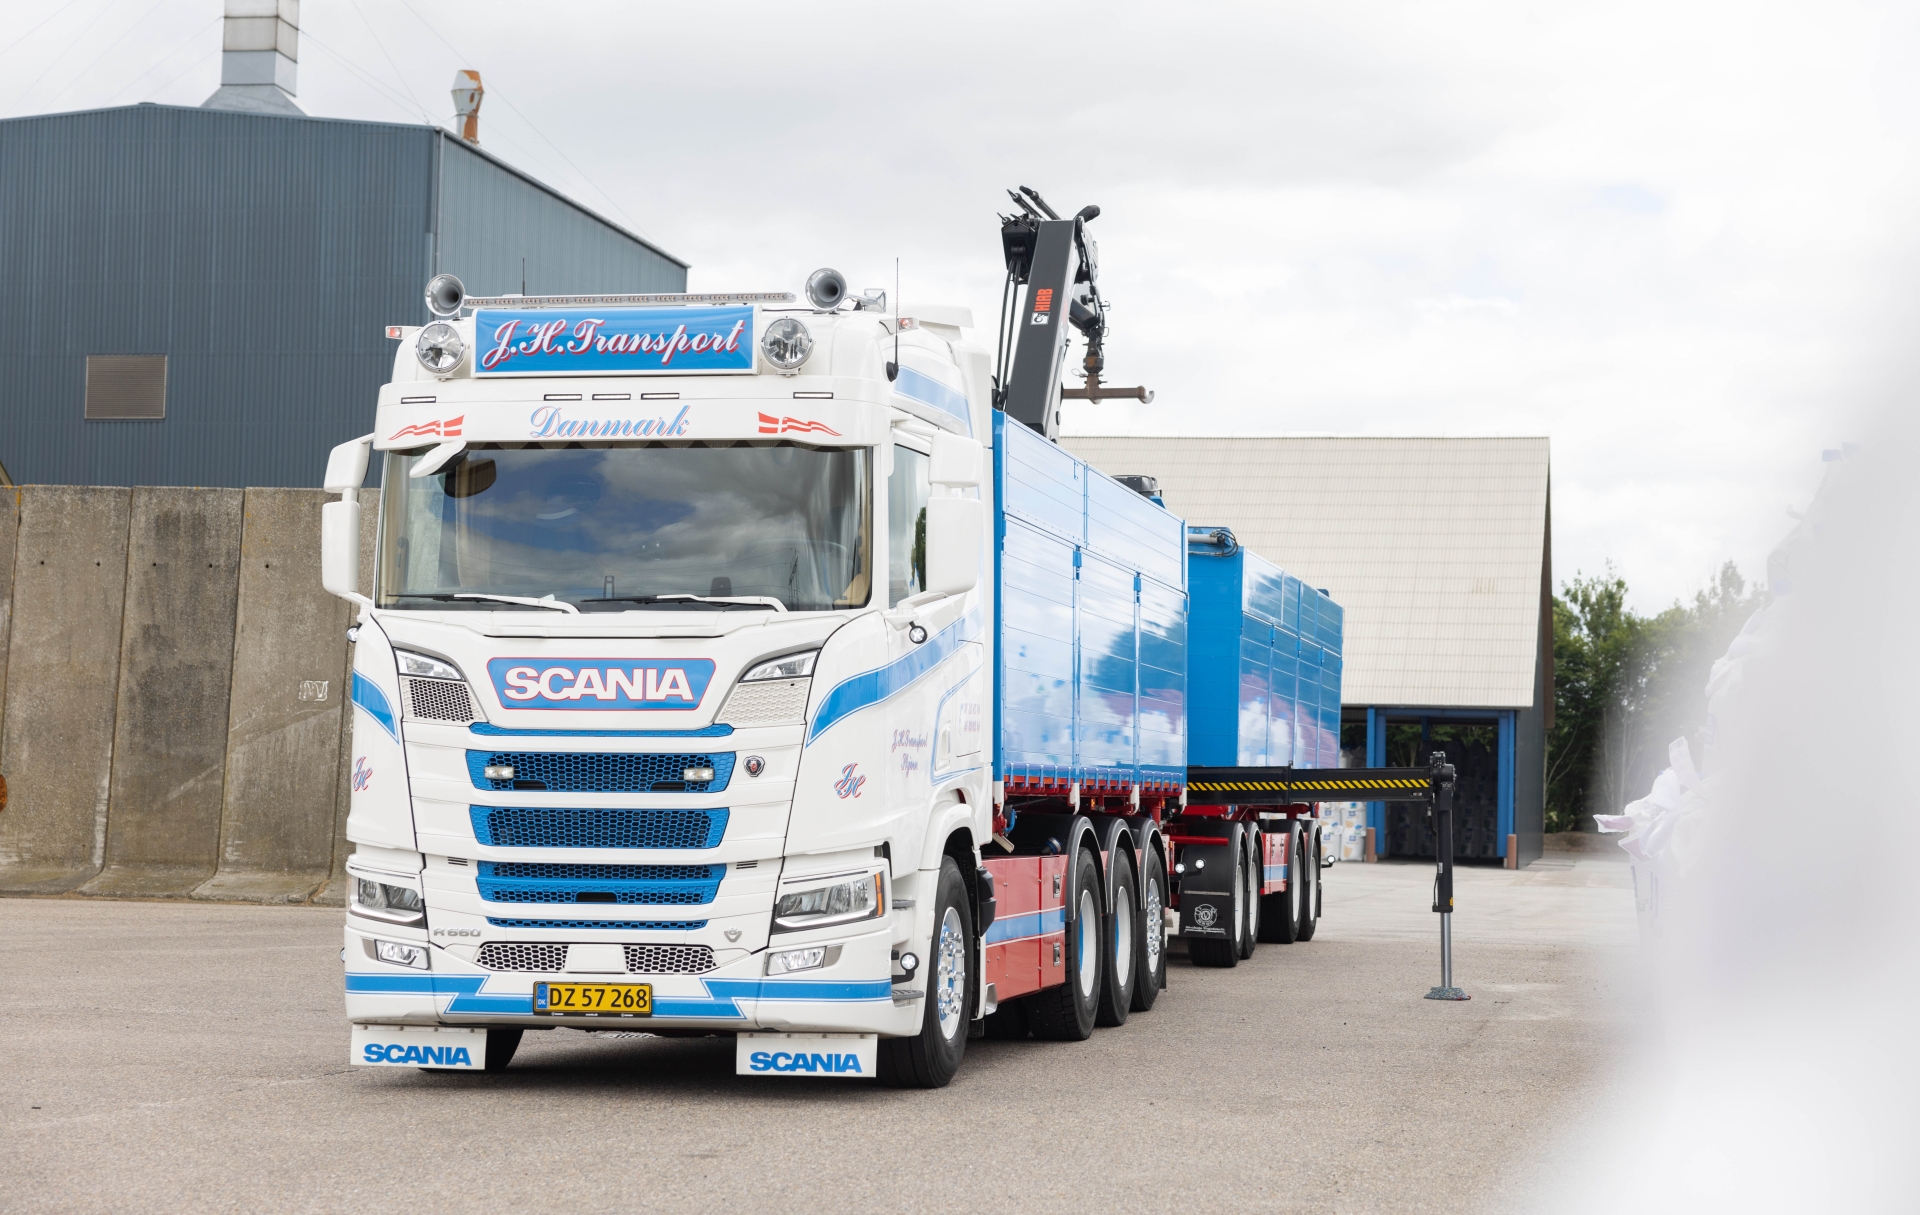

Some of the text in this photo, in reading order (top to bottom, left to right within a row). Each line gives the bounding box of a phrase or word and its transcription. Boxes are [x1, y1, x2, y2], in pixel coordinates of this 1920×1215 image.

[1034, 288, 1053, 311] HIAB
[529, 404, 691, 438] Danmark
[503, 666, 695, 702] SCANIA
[433, 927, 482, 938] R 660
[549, 988, 648, 1009] DZ 57 268
[363, 1043, 473, 1066] SCANIA
[749, 1051, 863, 1073] SCANIA
